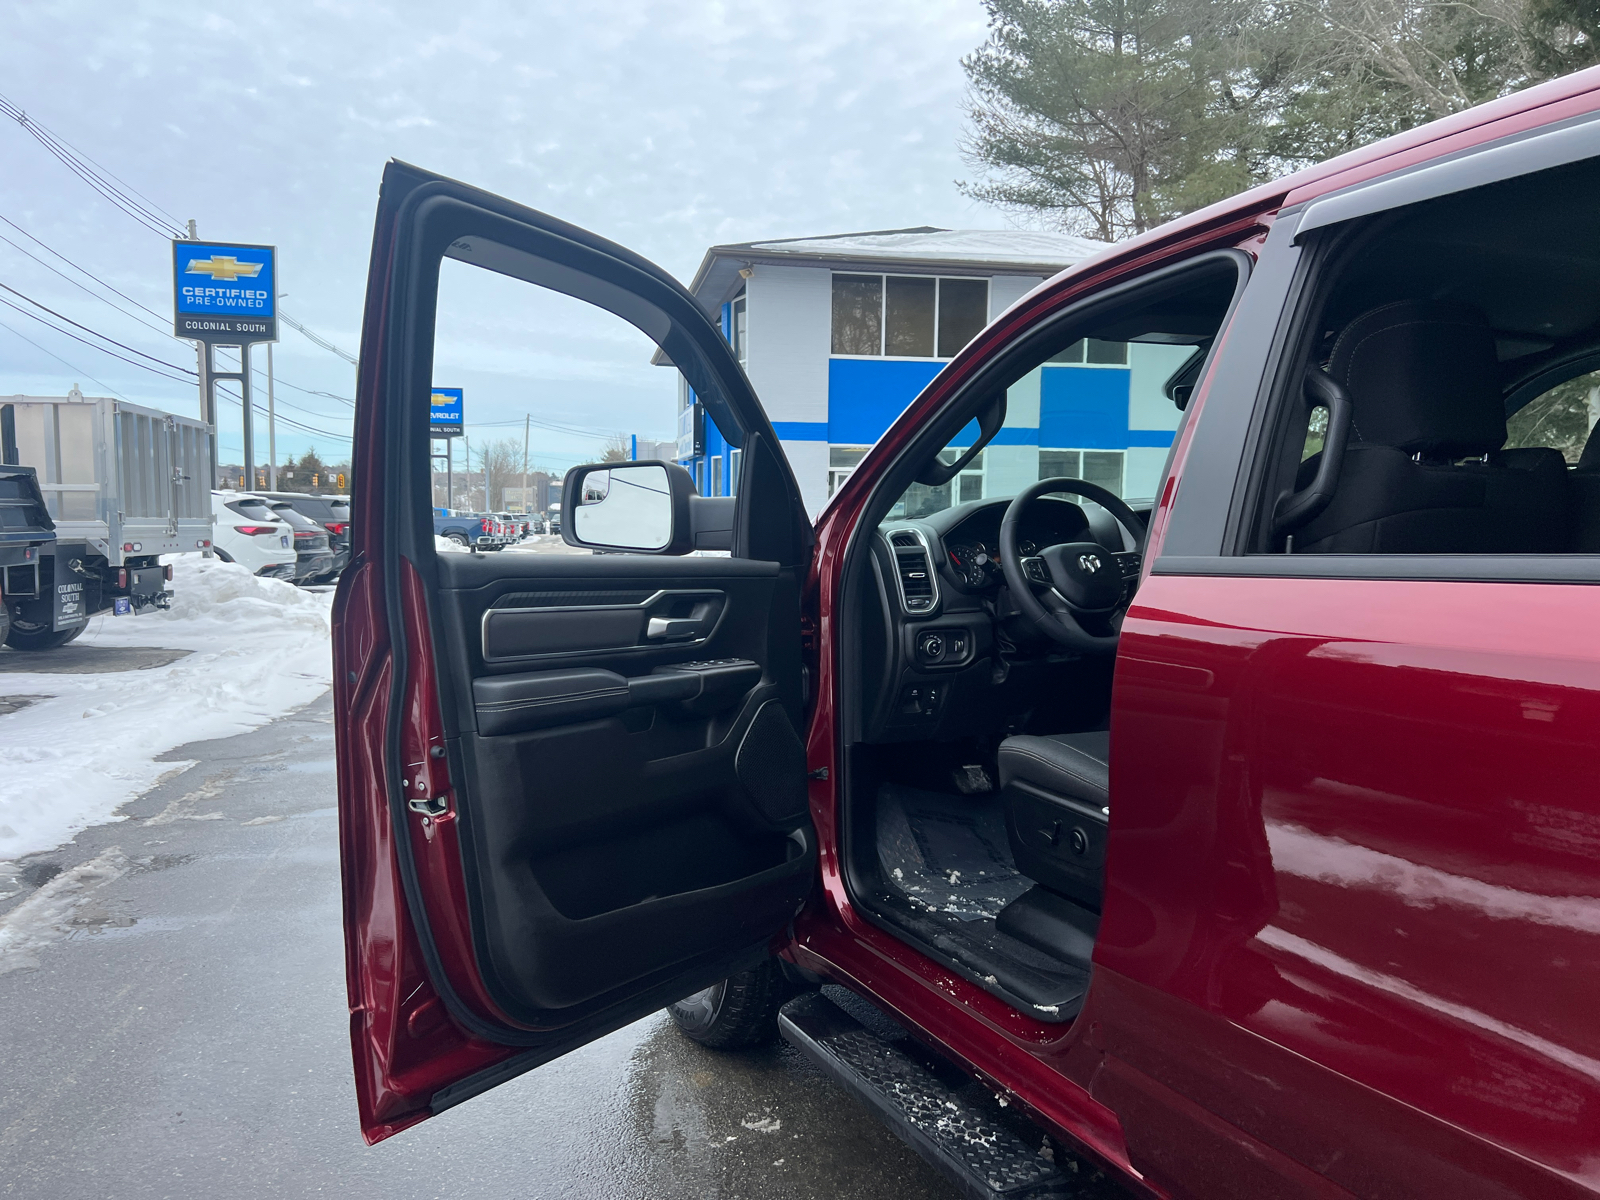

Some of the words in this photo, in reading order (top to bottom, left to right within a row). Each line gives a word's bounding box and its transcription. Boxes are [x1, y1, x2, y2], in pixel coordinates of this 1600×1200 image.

[182, 286, 268, 299] CERTIFIED
[186, 296, 264, 308] PRE-OWNED
[185, 321, 231, 331] COLONIAL
[236, 323, 266, 332] SOUTH
[430, 412, 460, 420] EVROLET
[57, 582, 83, 594] COLONIAL
[61, 592, 80, 603] SOUTH
